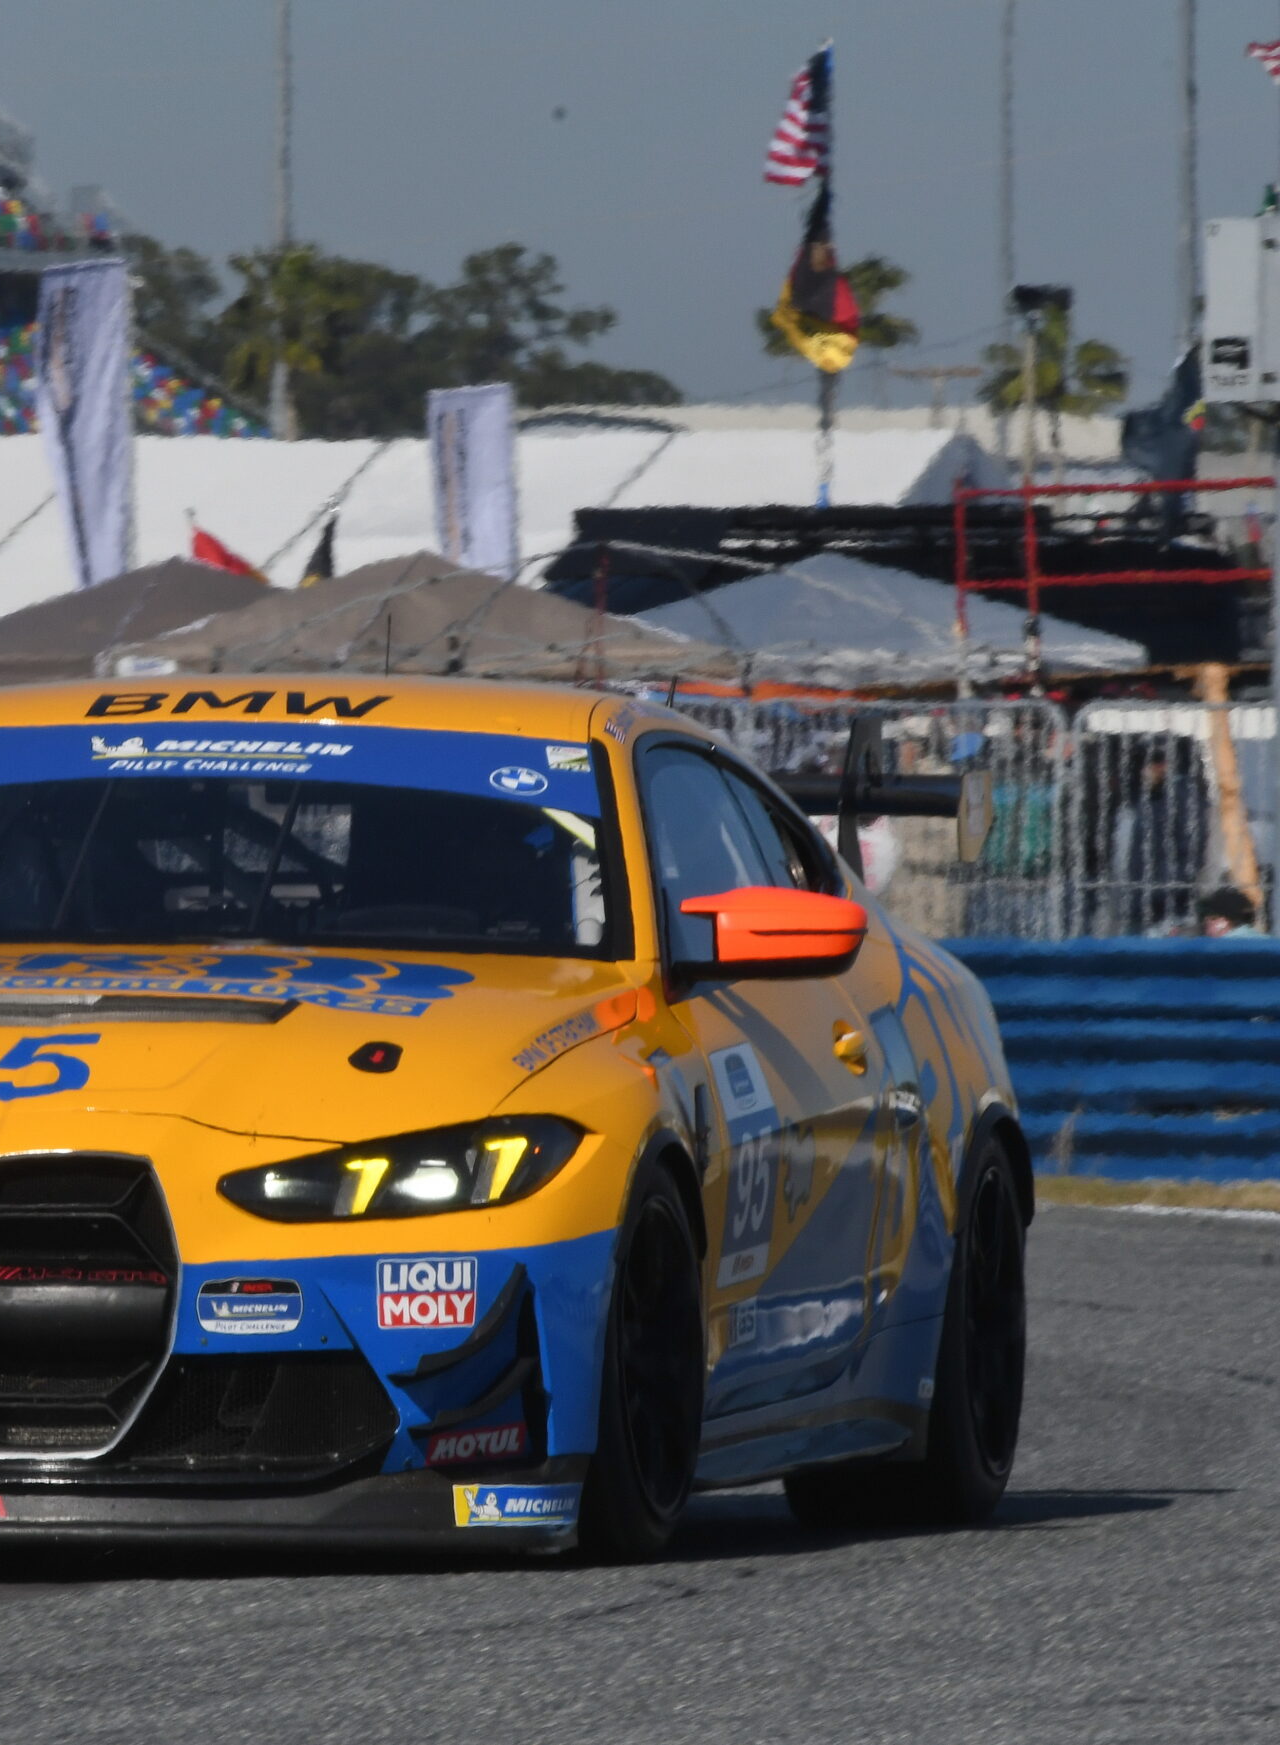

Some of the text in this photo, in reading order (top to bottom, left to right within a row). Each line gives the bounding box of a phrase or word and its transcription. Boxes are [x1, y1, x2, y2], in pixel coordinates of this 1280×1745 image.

[84, 690, 391, 719] BMW
[154, 740, 354, 756] MICHELIN
[108, 758, 313, 774] PILOT CHALLENGE
[732, 1122, 773, 1240] 95
[383, 1261, 471, 1293] LIQUI
[232, 1303, 288, 1313] MICHELIN
[383, 1293, 474, 1326] MOLY
[429, 1425, 521, 1462] MOTUL
[504, 1497, 576, 1514] MICHELIN
